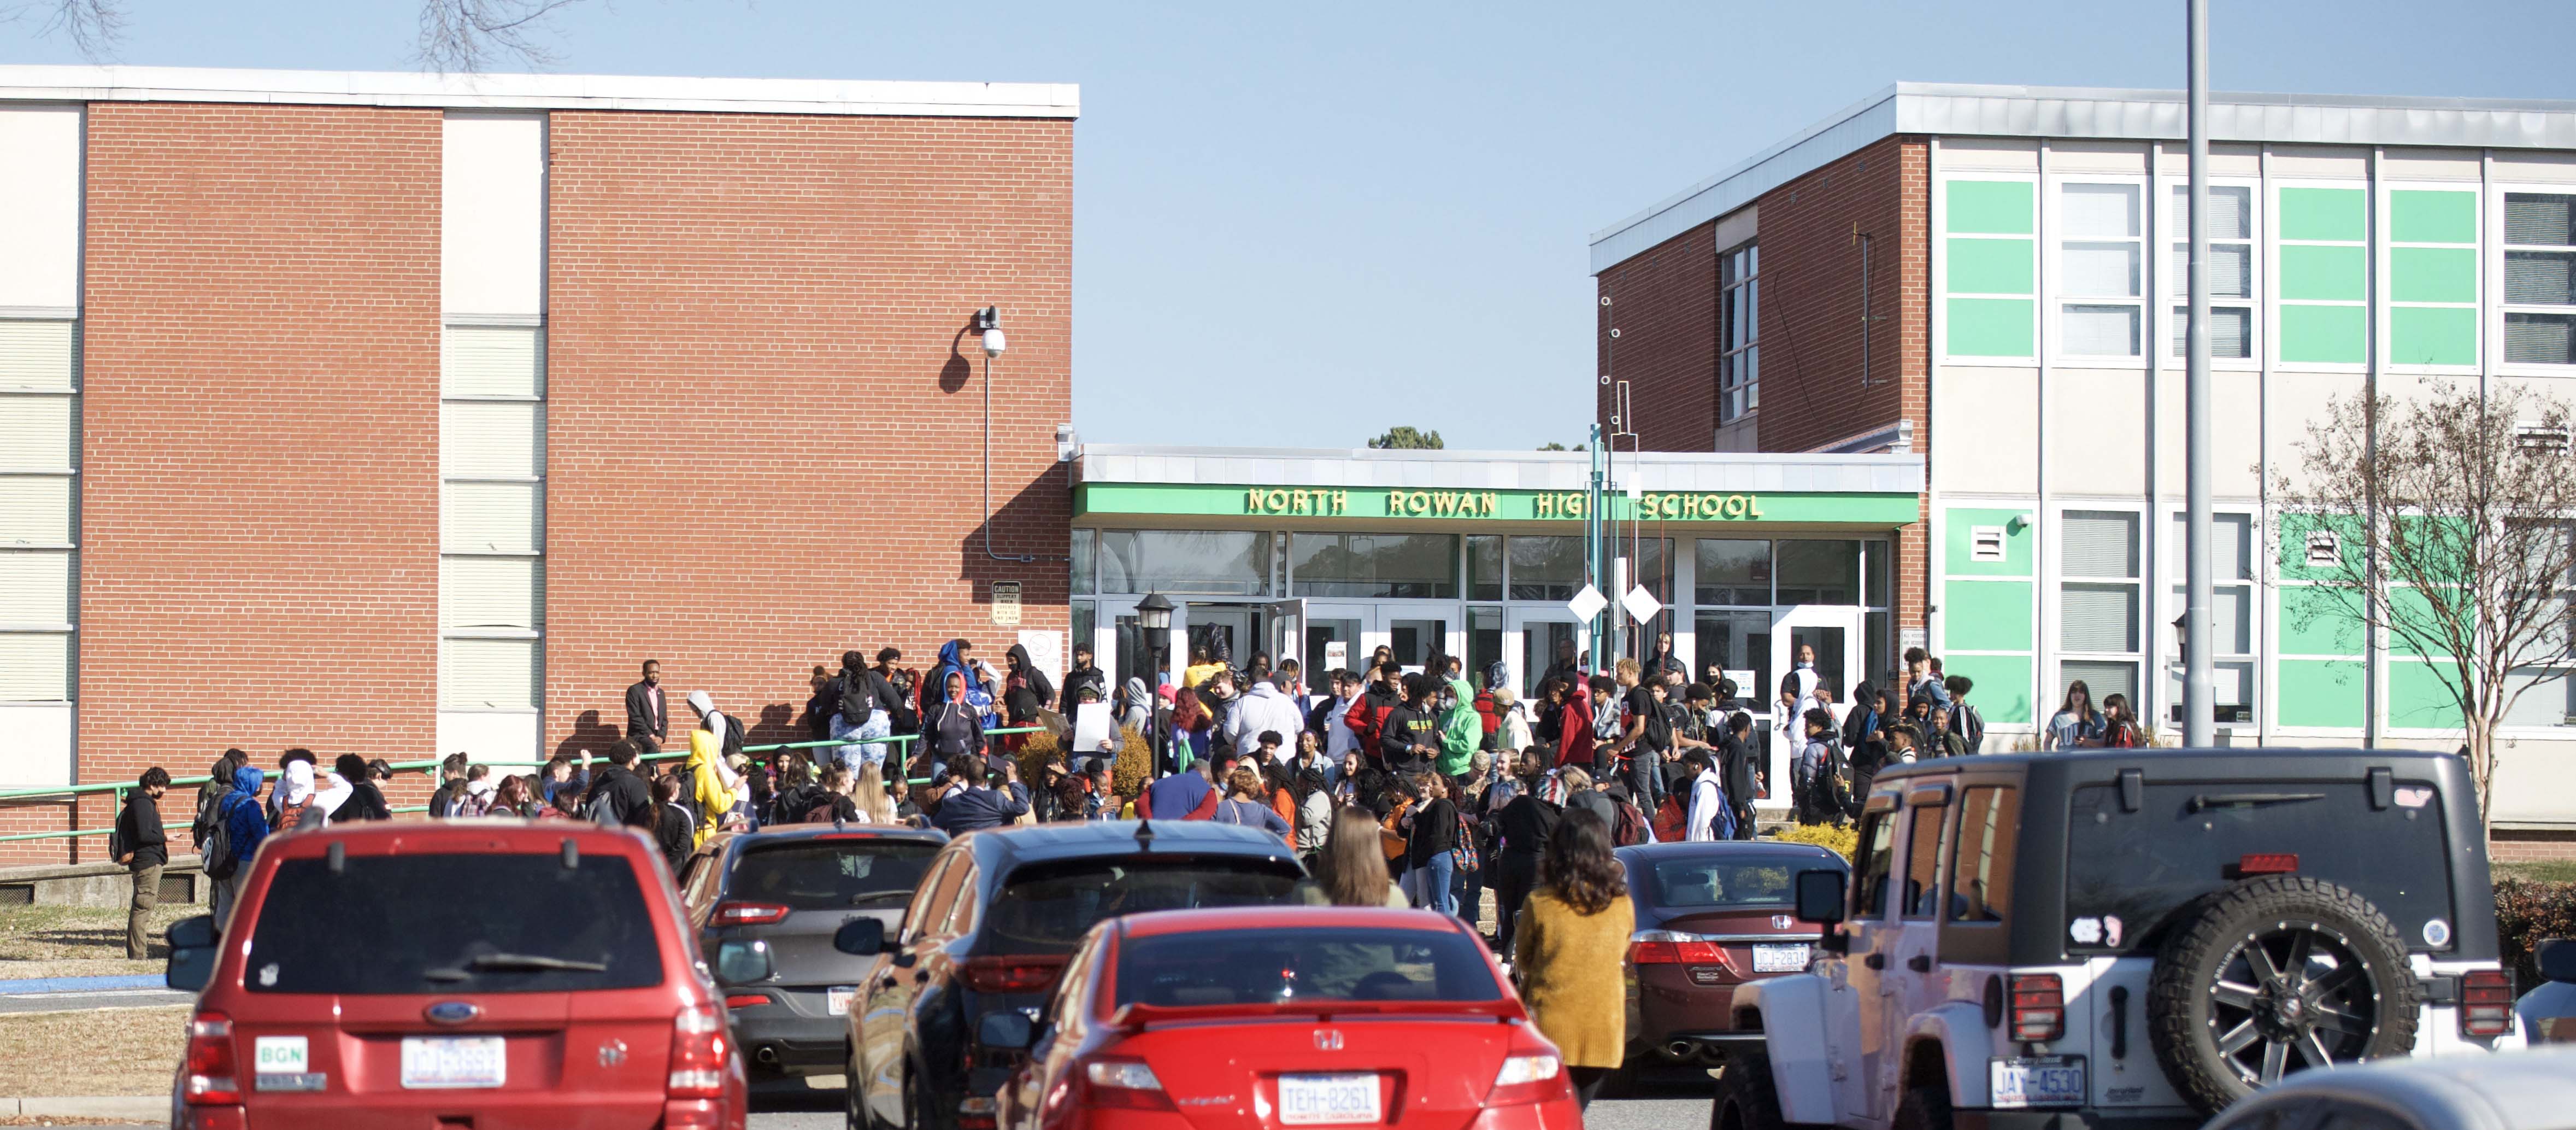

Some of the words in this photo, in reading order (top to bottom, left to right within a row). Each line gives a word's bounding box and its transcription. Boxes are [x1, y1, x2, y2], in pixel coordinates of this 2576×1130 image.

[1249, 489, 1346, 511] NORTH
[1390, 490, 1495, 513] ROWAN
[1645, 494, 1763, 516] SCHOOL
[262, 1047, 302, 1063] BGN
[1997, 1069, 2082, 1093] JAY-4530
[1285, 1086, 1371, 1111] TEH-8261
